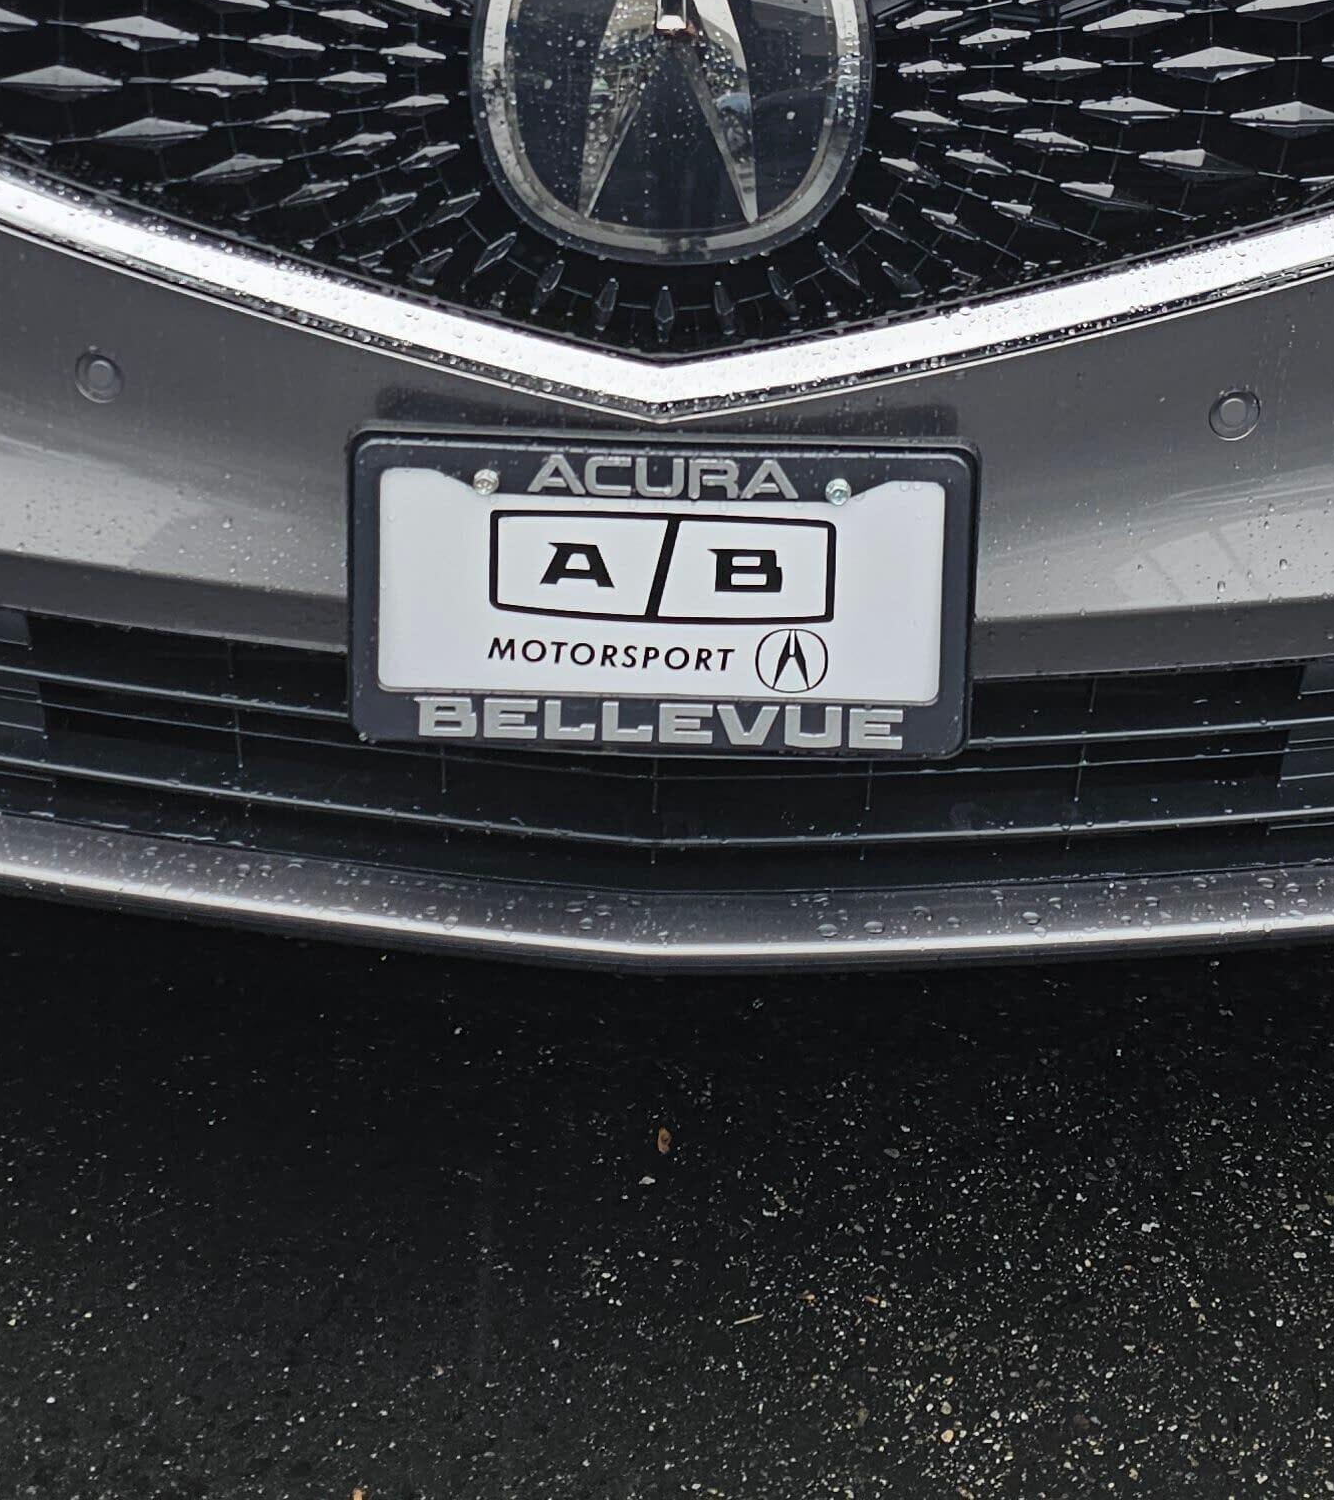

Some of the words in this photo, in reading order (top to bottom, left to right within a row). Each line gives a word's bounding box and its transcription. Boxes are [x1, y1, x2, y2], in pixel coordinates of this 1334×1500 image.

[526, 454, 798, 499] ACURA
[539, 542, 615, 588] A
[707, 548, 783, 593] B
[487, 636, 736, 673] MOTORSPORT
[413, 696, 904, 750] BELLEVUE
